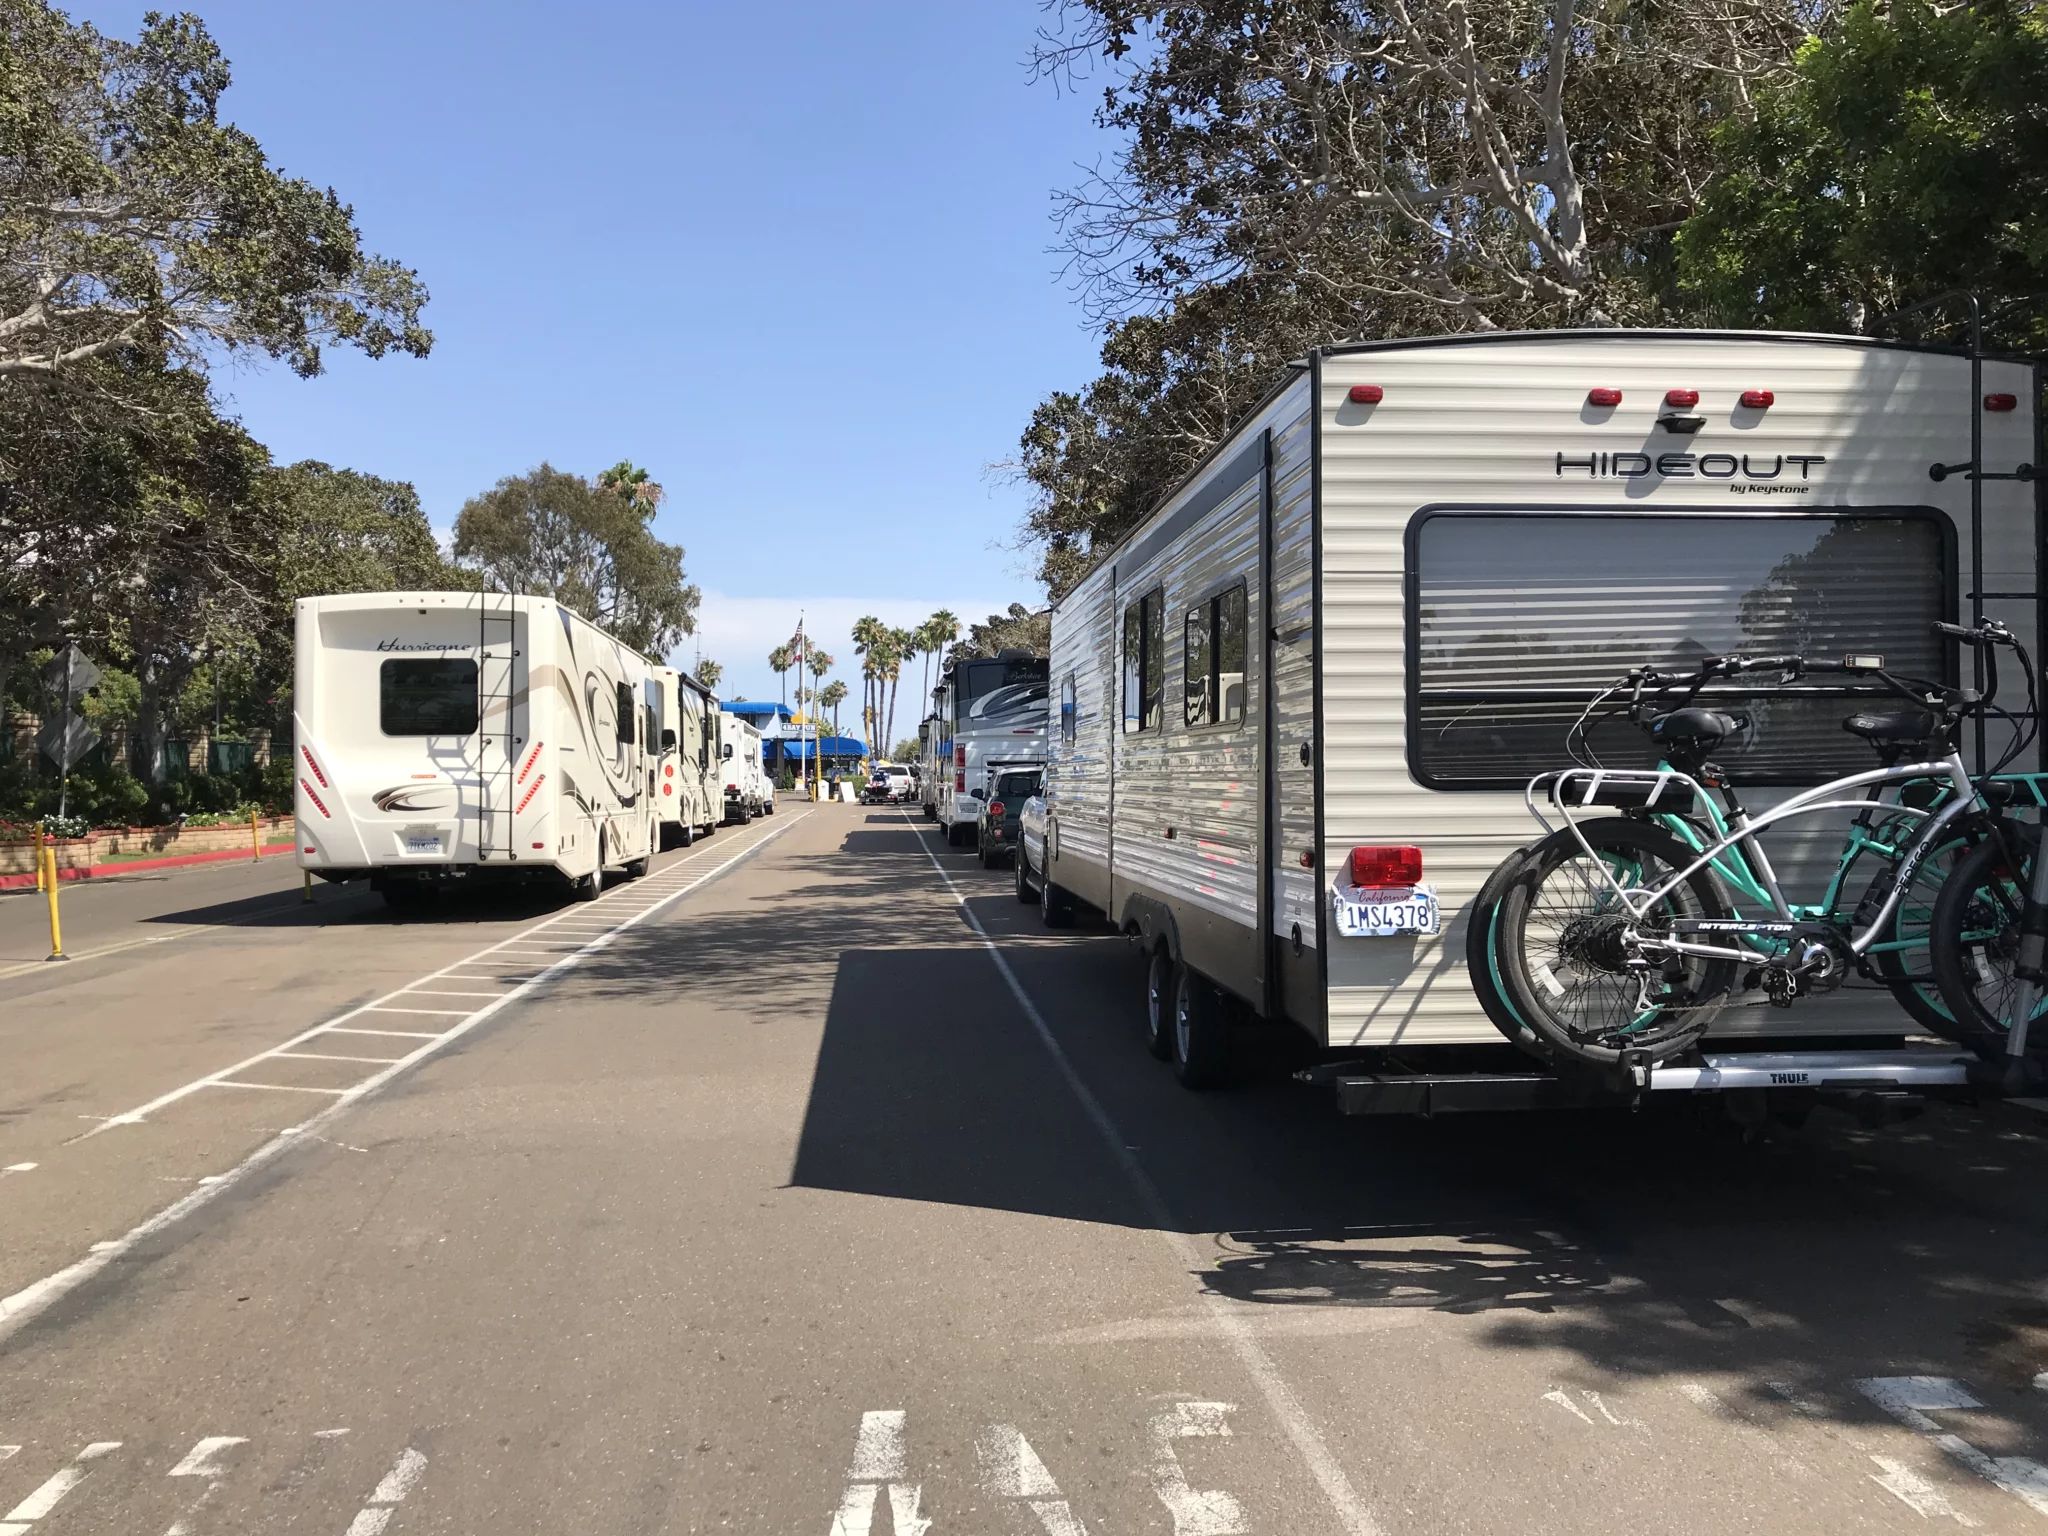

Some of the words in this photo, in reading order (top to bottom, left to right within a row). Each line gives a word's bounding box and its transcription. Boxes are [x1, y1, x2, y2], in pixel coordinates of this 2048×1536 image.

[1555, 452, 1825, 481] HIDEOUT
[1729, 483, 1746, 494] by
[1748, 484, 1809, 494] Keystone
[376, 637, 471, 652] Hurricane
[1893, 840, 1930, 896] PEDEGO
[1358, 891, 1411, 905] California
[1347, 905, 1430, 929] 1MS4378
[1698, 922, 1793, 932] INTERCEPTOR
[1769, 1073, 1809, 1084] THULE
